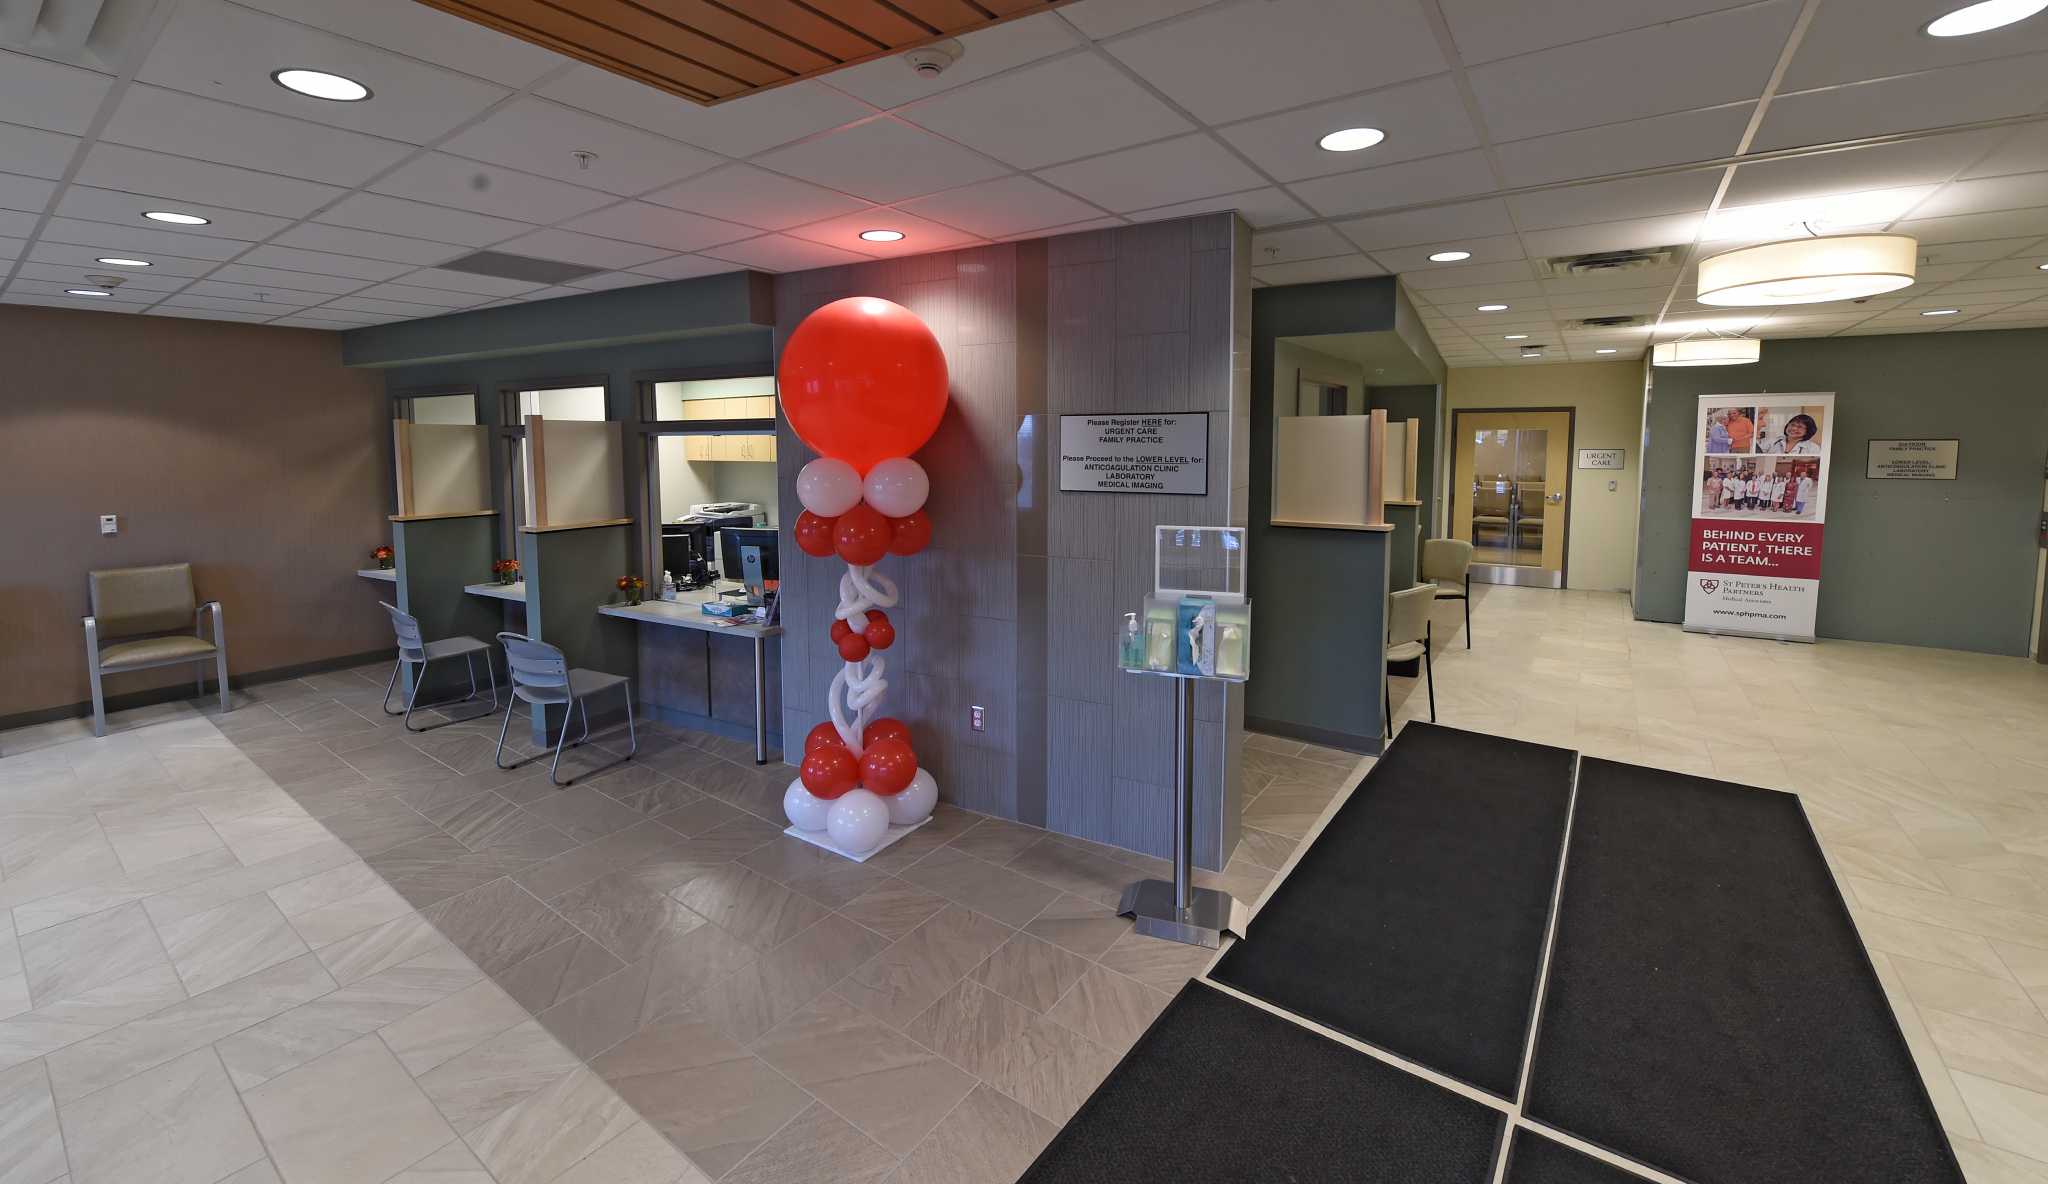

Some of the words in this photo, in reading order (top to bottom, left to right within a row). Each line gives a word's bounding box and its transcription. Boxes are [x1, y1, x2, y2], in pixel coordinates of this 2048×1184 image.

[1087, 418, 1110, 426] Please
[1111, 418, 1139, 427] Register
[1141, 418, 1162, 427] HERE
[1136, 456, 1163, 464] LOWER
[1164, 456, 1190, 464] LEVEL
[1084, 464, 1152, 472] ANTICOAGULATION
[1154, 465, 1179, 473] CLINIC
[1703, 529, 1754, 541] BEHIND
[1758, 532, 1805, 543] EVERY
[1702, 542, 1762, 555] PATIENT,
[1766, 544, 1813, 556] THERE
[1701, 553, 1713, 562] IS
[1715, 554, 1726, 563] A
[1728, 554, 1779, 567] TEAM...
